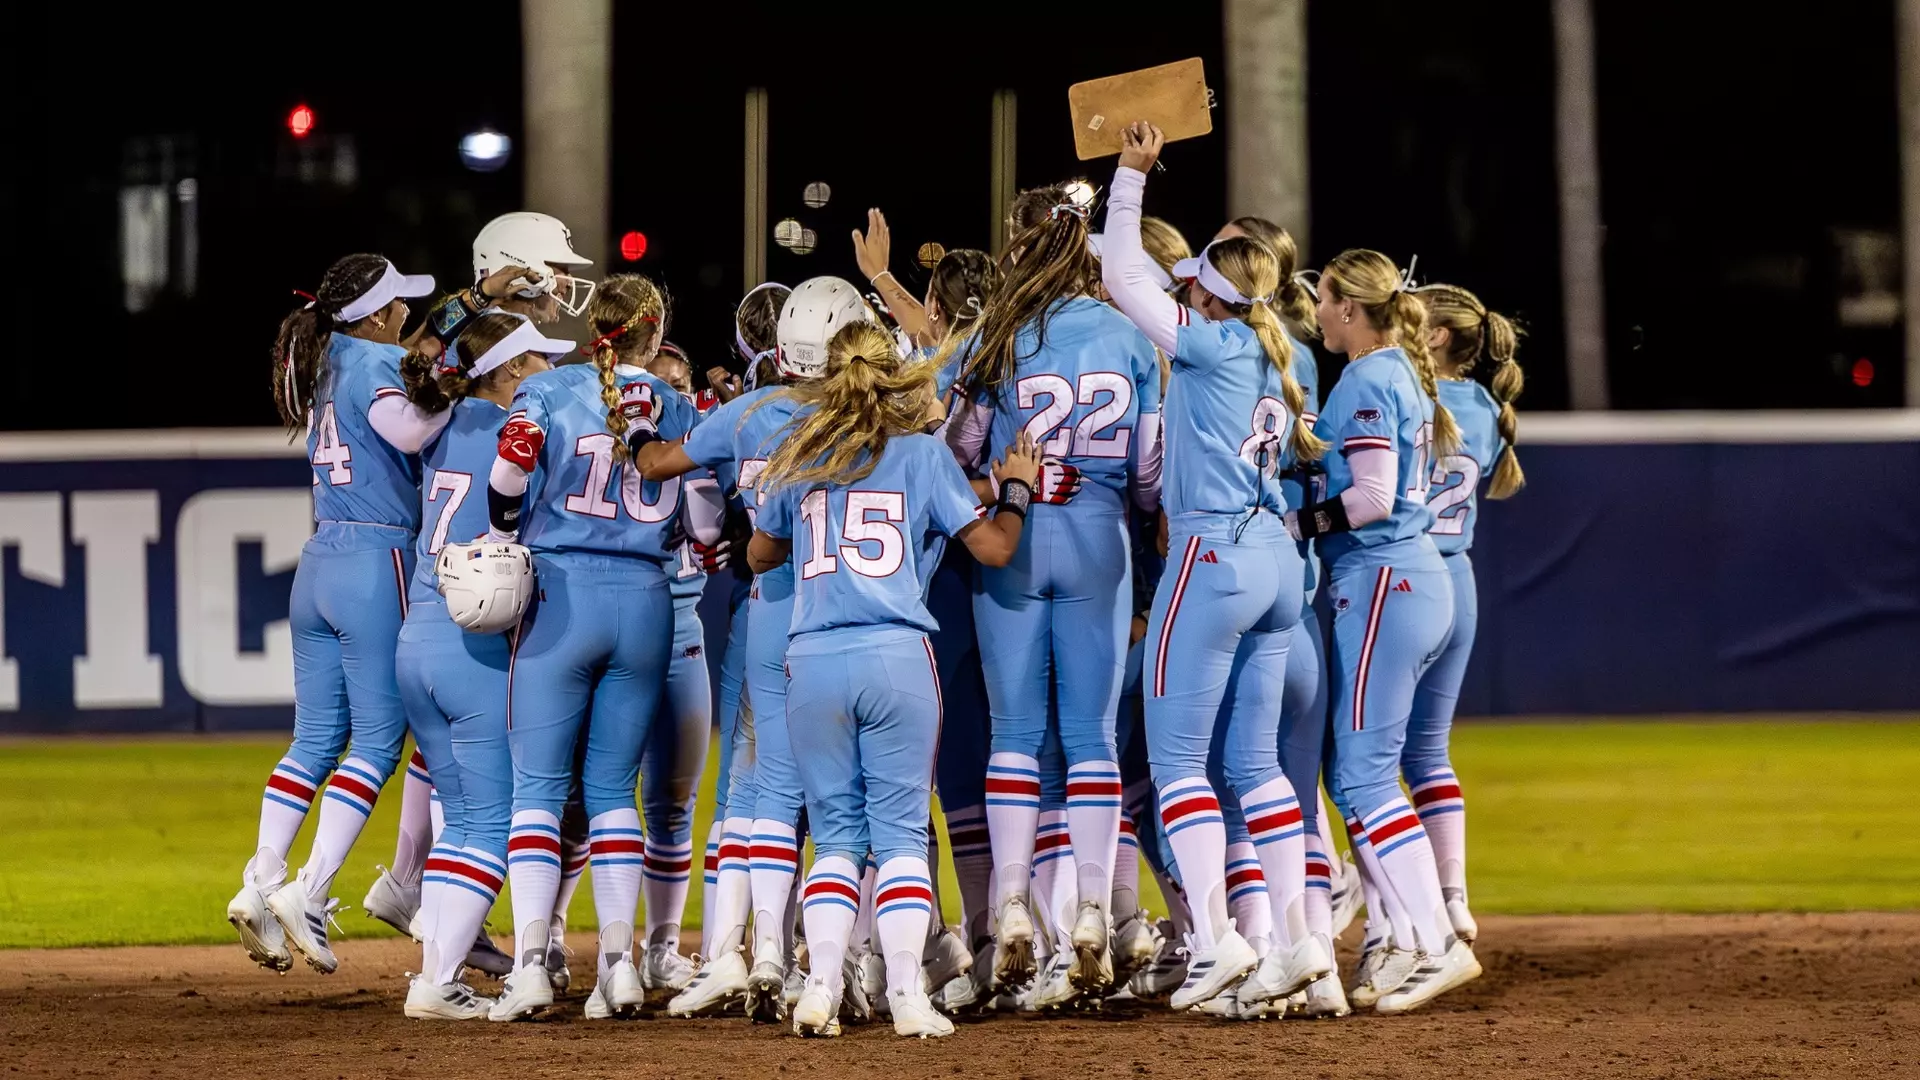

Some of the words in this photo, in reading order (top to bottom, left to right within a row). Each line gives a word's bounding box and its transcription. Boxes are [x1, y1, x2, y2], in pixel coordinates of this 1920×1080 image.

[306, 401, 352, 486] 4
[1016, 371, 1132, 459] 22
[1238, 396, 1288, 480] 8
[427, 469, 473, 555] 7
[565, 433, 682, 523] 10
[1425, 454, 1481, 536] 2
[800, 488, 905, 581] 15
